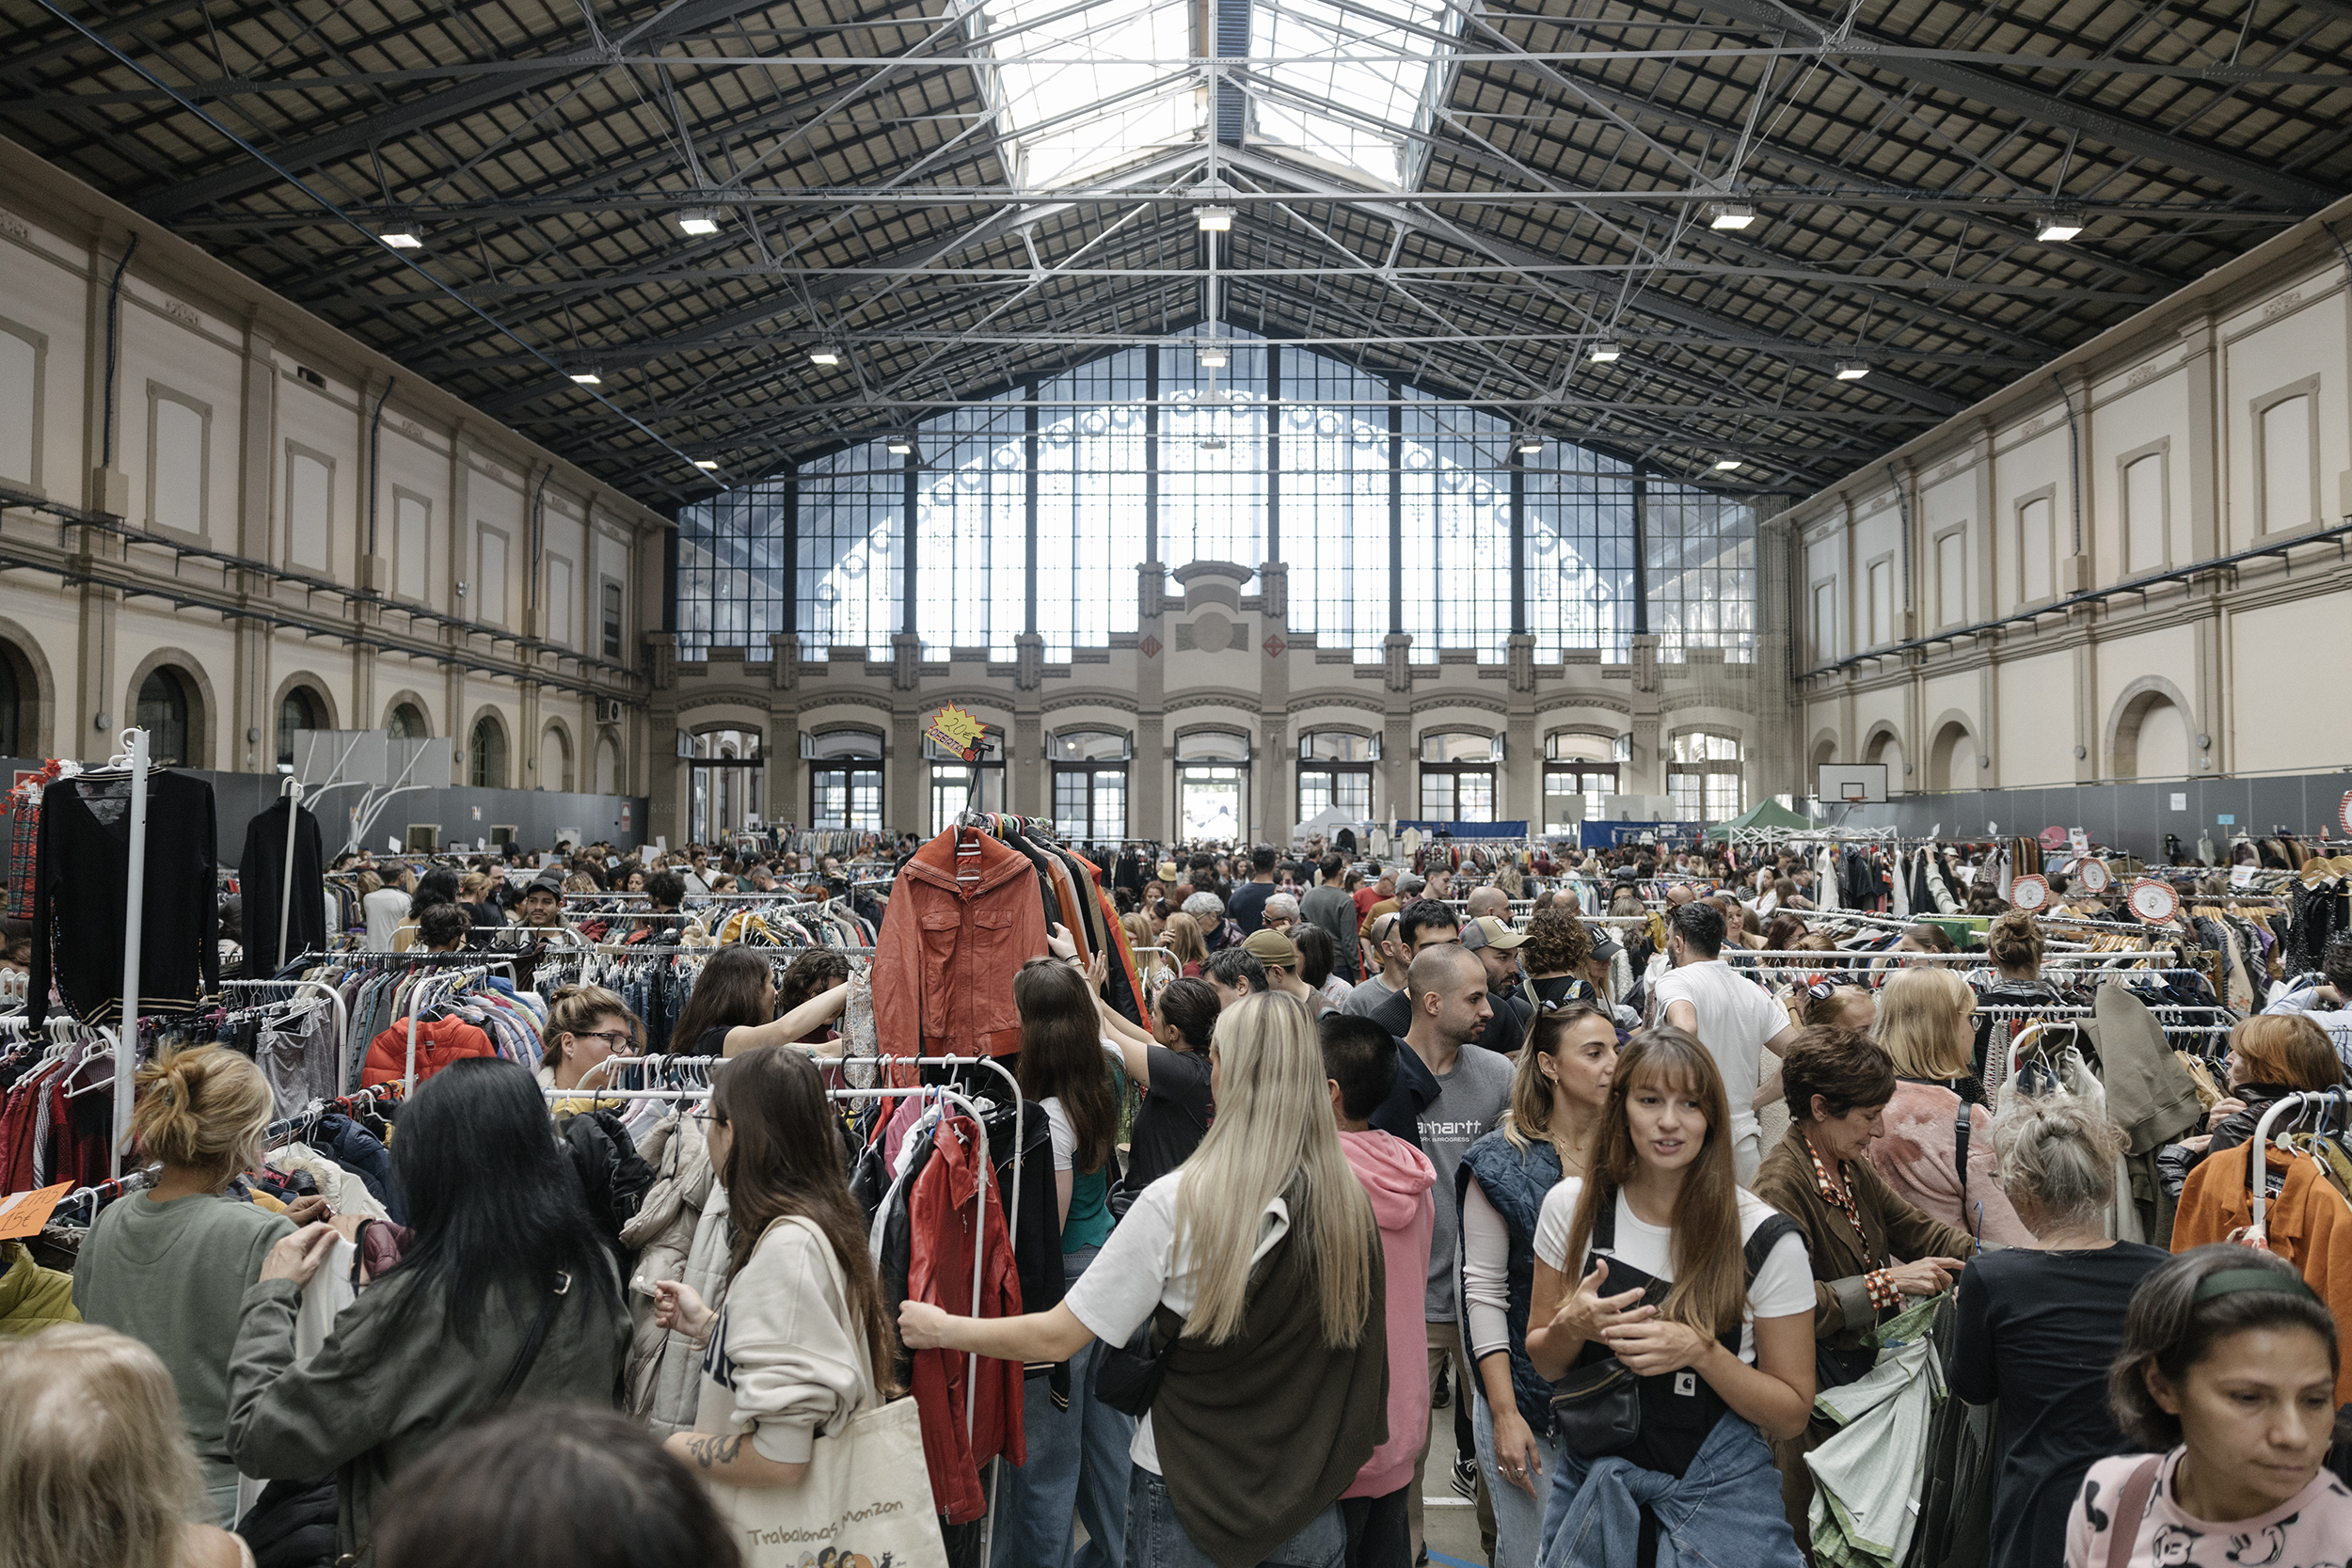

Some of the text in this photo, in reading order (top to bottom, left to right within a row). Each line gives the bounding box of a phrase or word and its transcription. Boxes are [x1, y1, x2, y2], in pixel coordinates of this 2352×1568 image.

[930, 728, 964, 753] OFERTA
[944, 717, 976, 741] 20€
[1417, 1119, 1482, 1134] arhartt
[0, 1209, 40, 1231] 15€
